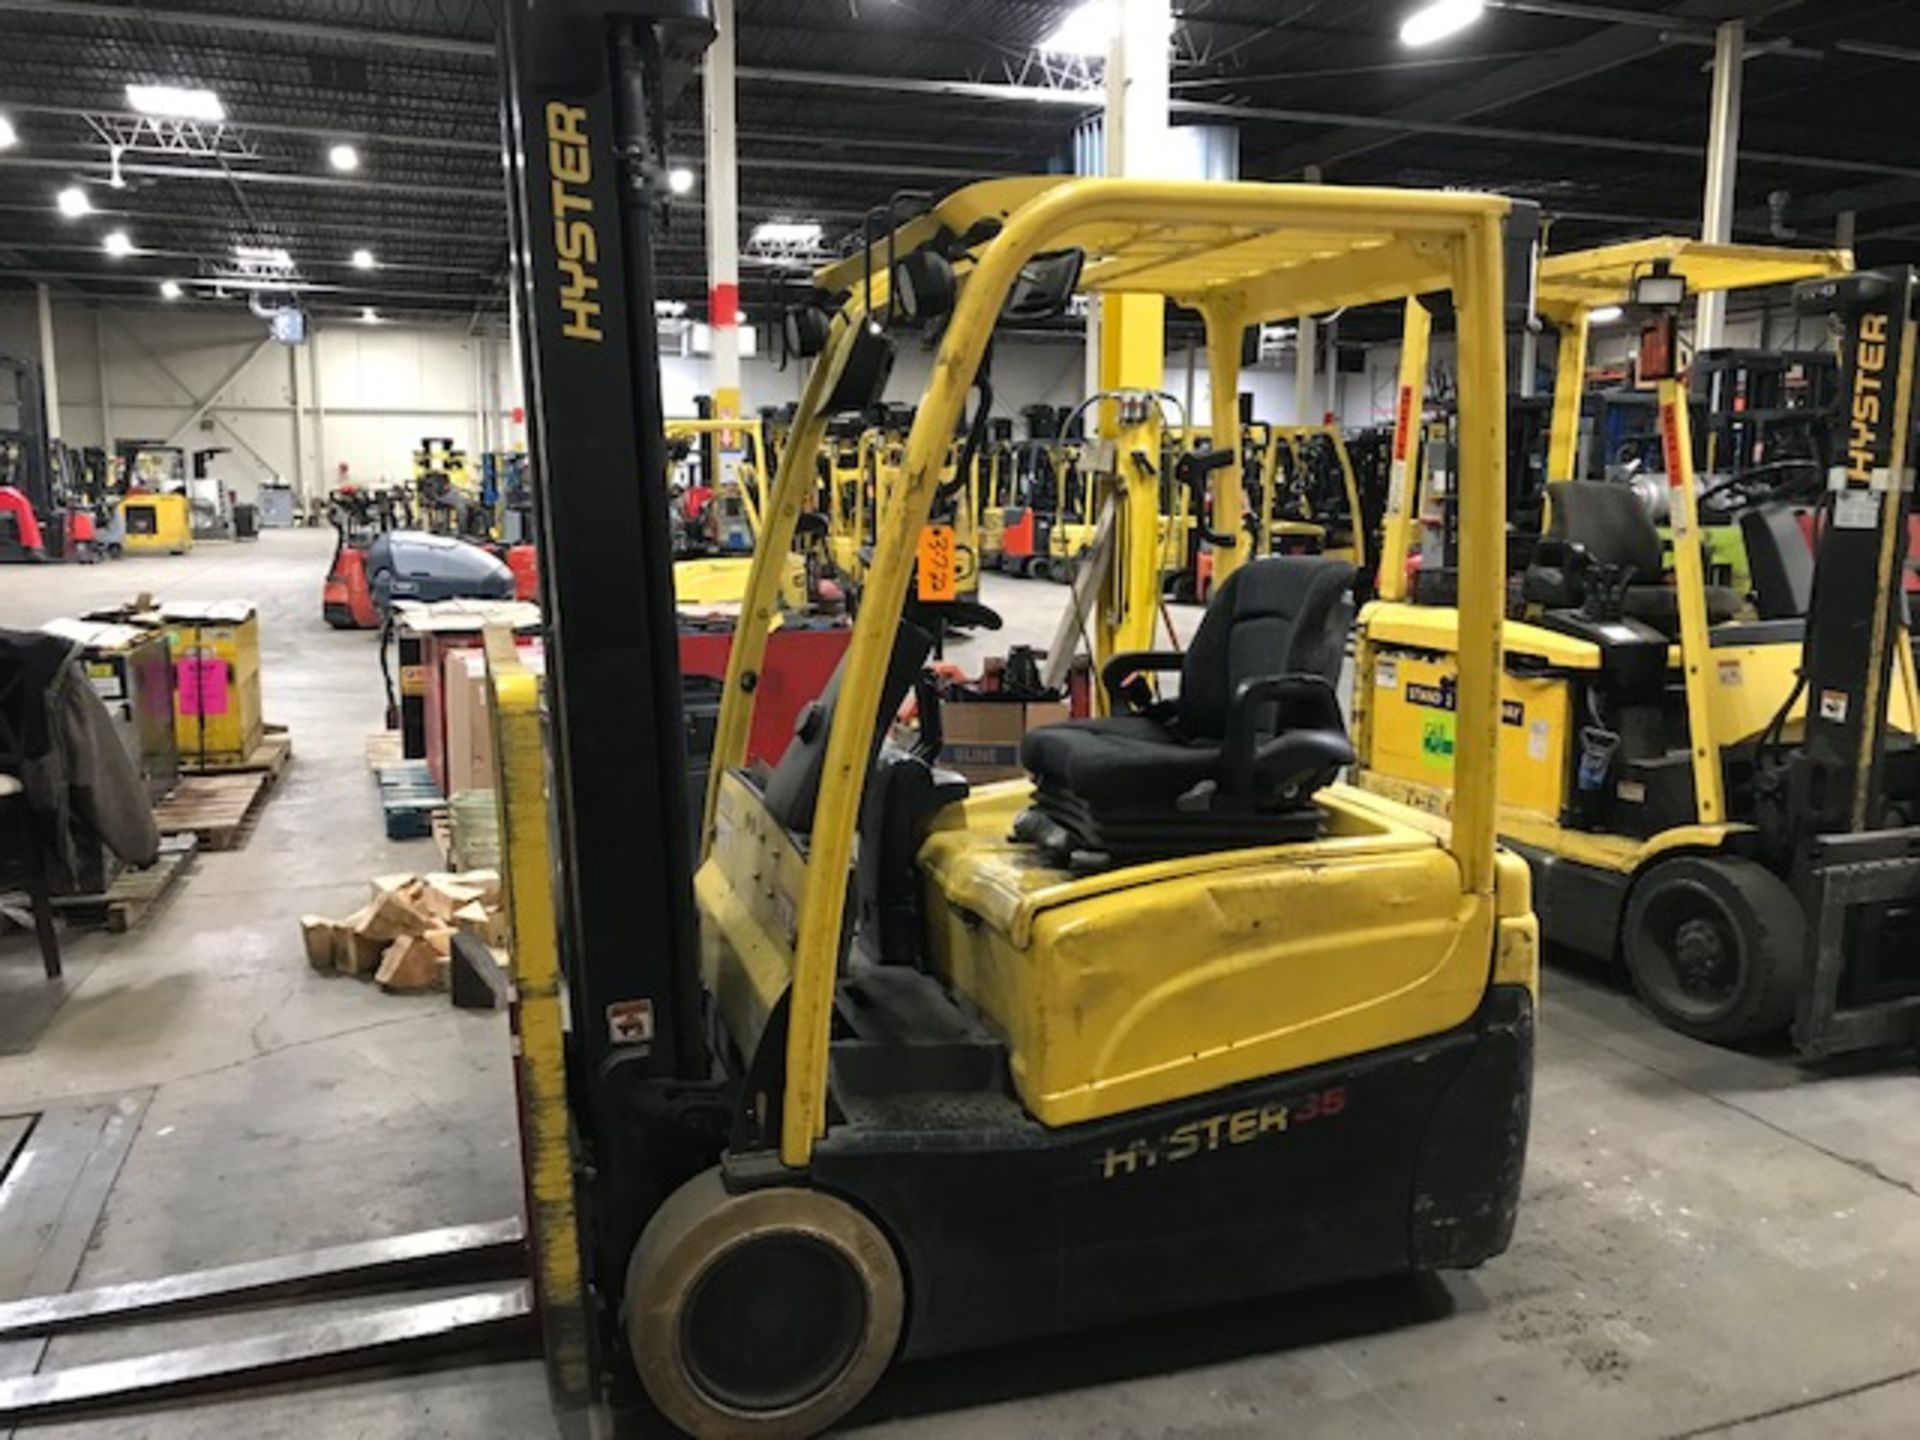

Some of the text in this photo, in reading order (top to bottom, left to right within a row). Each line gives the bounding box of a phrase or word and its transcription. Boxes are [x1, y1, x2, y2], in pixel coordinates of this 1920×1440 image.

[546, 101, 602, 341] HYSTER
[1847, 312, 1888, 482] HYSTER
[1103, 1104, 1289, 1178] HYSTER
